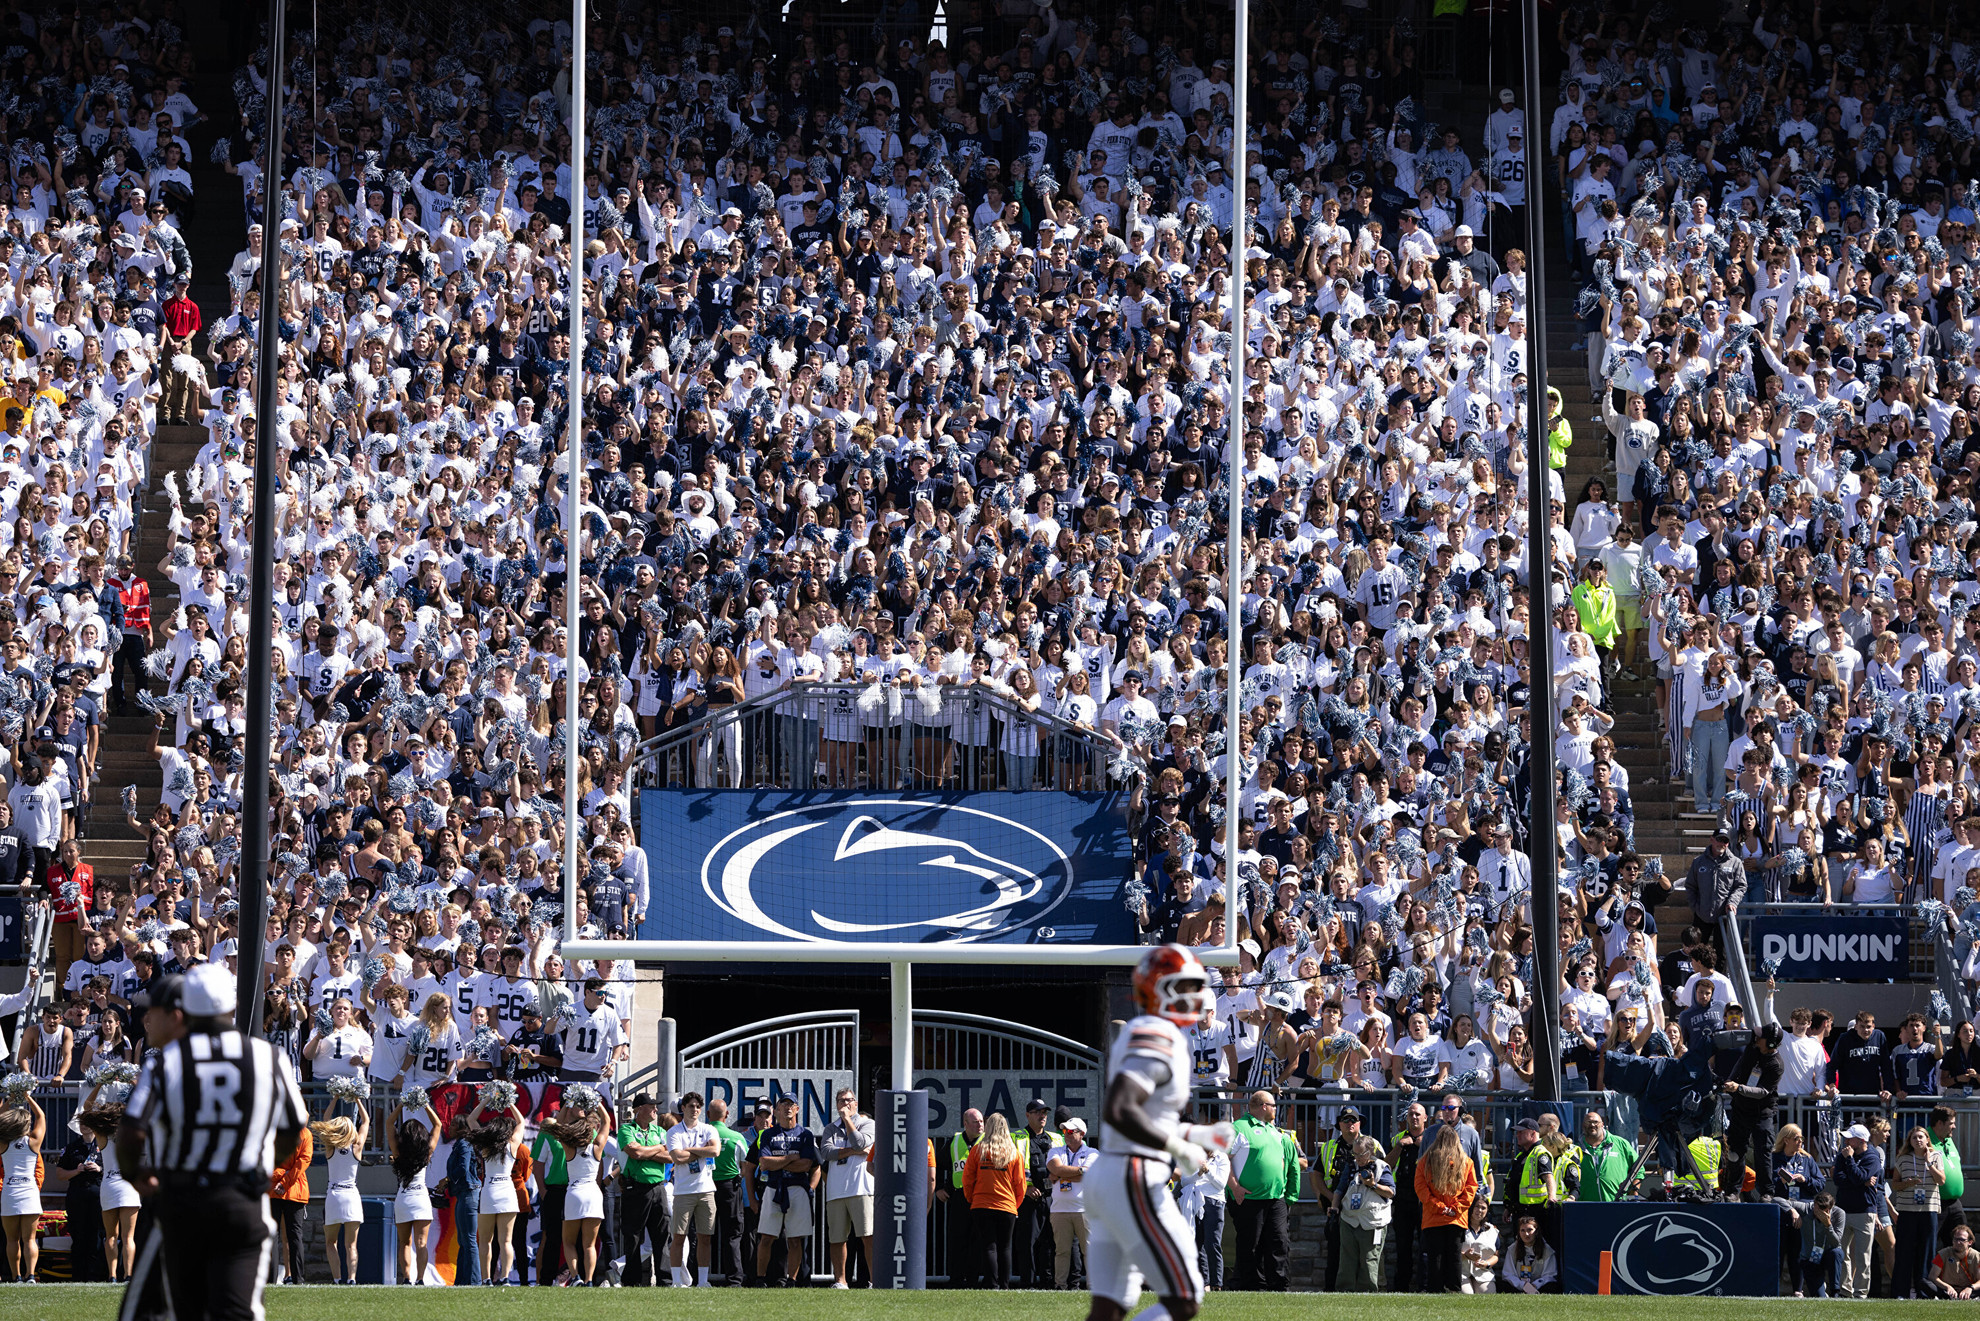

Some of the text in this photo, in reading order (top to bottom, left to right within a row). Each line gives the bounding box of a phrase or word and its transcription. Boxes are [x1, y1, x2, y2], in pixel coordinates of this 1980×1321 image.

[1701, 112, 1718, 122] PEN
[1107, 136, 1132, 145] PENN STATE
[1502, 160, 1524, 181] 26
[1219, 191, 1226, 199] S
[798, 231, 823, 240] PENN STATE
[1602, 229, 1616, 241] 11
[1827, 229, 1842, 244] S
[1170, 270, 1182, 286] S
[711, 285, 734, 307] 14
[1377, 279, 1386, 296] 1
[762, 289, 773, 304] S
[142, 308, 156, 320] STATE
[981, 303, 990, 313] 26
[528, 309, 550, 334] 20
[57, 335, 68, 350] S
[1054, 335, 1068, 354] S
[1507, 350, 1519, 367] S
[113, 391, 125, 409] S
[494, 410, 506, 428] S
[1308, 411, 1319, 428] S
[1468, 404, 1481, 421] S
[1463, 418, 1482, 428] ZONE
[679, 444, 689, 462] S
[1380, 494, 1392, 508] S
[99, 508, 111, 523] S
[1057, 503, 1070, 521] S
[1151, 513, 1162, 528] S
[21, 546, 33, 564] S
[404, 553, 416, 567] S
[481, 567, 494, 584] S
[1370, 584, 1394, 607] 15
[1046, 613, 1058, 628] S
[1087, 657, 1101, 674] S
[320, 668, 334, 687] S
[646, 679, 661, 687] ZON
[1264, 674, 1281, 687] STATE
[1069, 703, 1082, 720] S
[1563, 740, 1592, 750] PENN STAT
[1430, 762, 1448, 771] PENN
[1399, 800, 1419, 818] 26
[1, 835, 18, 847] STATE
[1497, 864, 1508, 892] 1
[606, 885, 622, 896] STATE
[1584, 876, 1609, 898] 26
[1762, 933, 1902, 962] DUNKIN'
[1676, 960, 1689, 968] PENN
[66, 972, 72, 982] 6
[457, 987, 474, 1015] 5
[497, 992, 525, 1022] 26
[1226, 1013, 1249, 1040] 11
[1690, 1011, 1721, 1025] PENN STATE
[332, 1036, 344, 1060] 1
[454, 1041, 462, 1052] 2
[576, 1026, 598, 1054] 11
[1559, 1034, 1585, 1050] STATE
[422, 1046, 449, 1073] 26
[1849, 1045, 1881, 1058] PENN STATE
[1192, 1050, 1219, 1075] 15
[1361, 1058, 1385, 1074] STATE
[1906, 1058, 1920, 1086] 1
[195, 1061, 245, 1126] R
[704, 1076, 834, 1129] PENN
[912, 1076, 1089, 1129] STATE
[892, 1092, 907, 1290] PENN STATE
